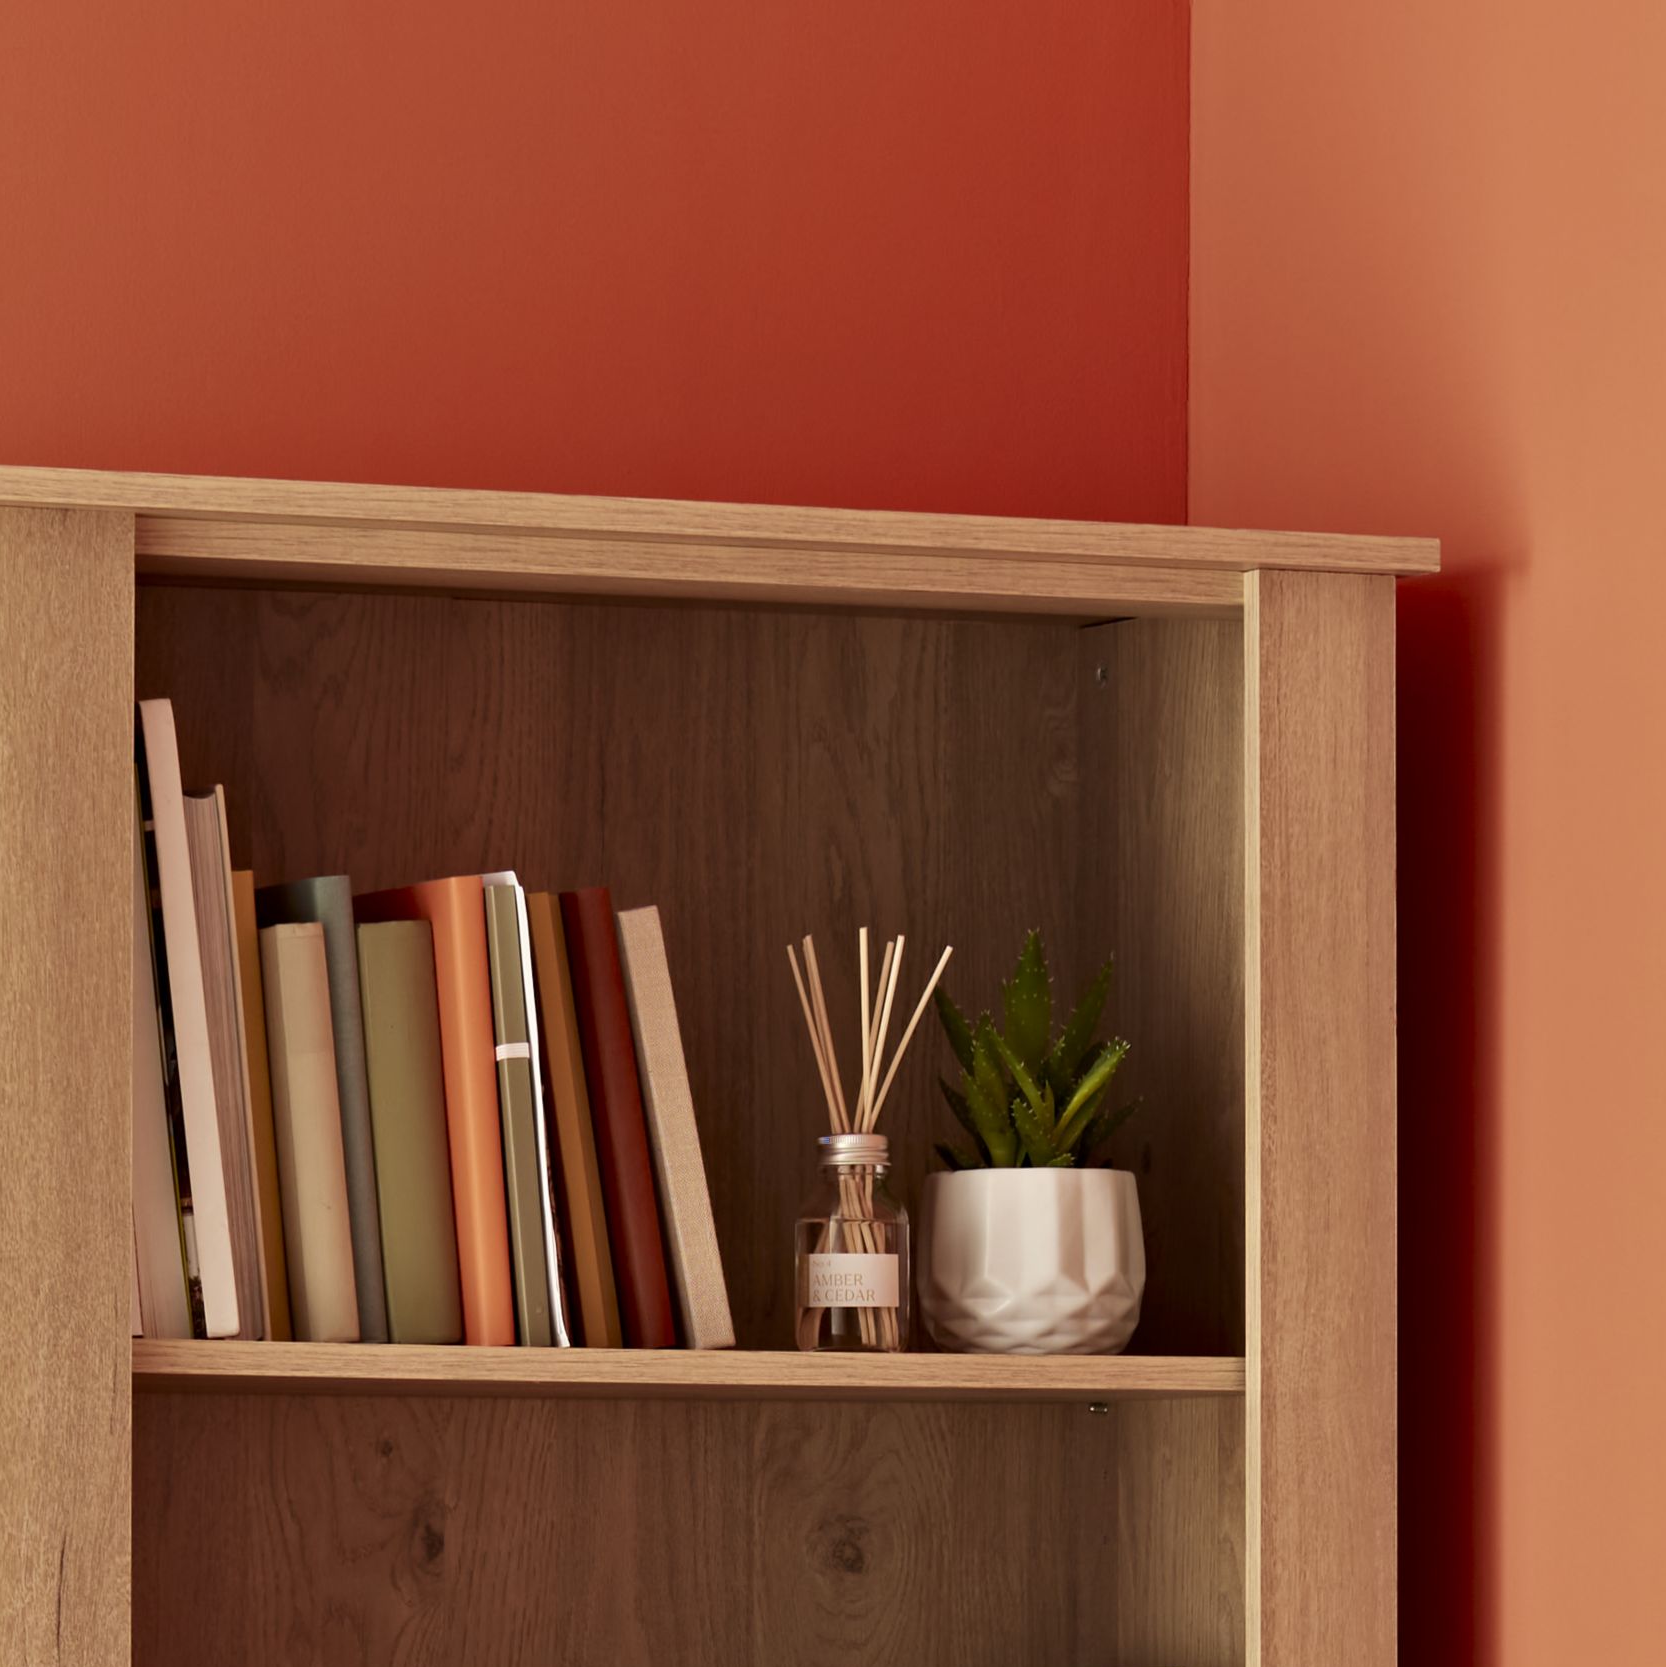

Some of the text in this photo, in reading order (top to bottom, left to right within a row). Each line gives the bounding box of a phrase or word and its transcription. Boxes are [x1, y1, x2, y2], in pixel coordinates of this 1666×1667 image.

[812, 1273, 863, 1286] AMBER
[812, 1288, 875, 1302] & CEDAR
